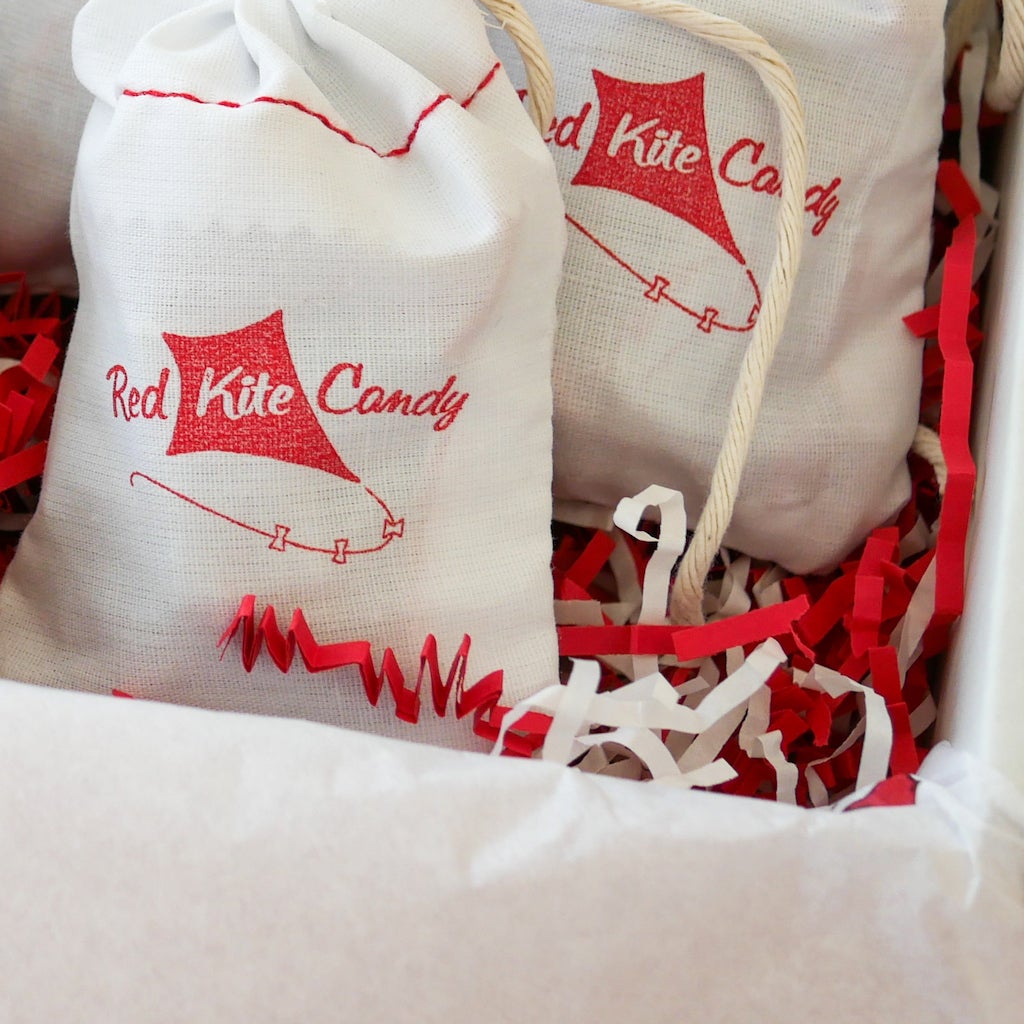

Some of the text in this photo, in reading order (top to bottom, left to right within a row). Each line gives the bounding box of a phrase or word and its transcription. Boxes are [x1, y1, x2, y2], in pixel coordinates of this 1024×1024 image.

[607, 113, 703, 174] Kite
[719, 138, 842, 236] Cady
[106, 362, 469, 431] Red Kite Candy
